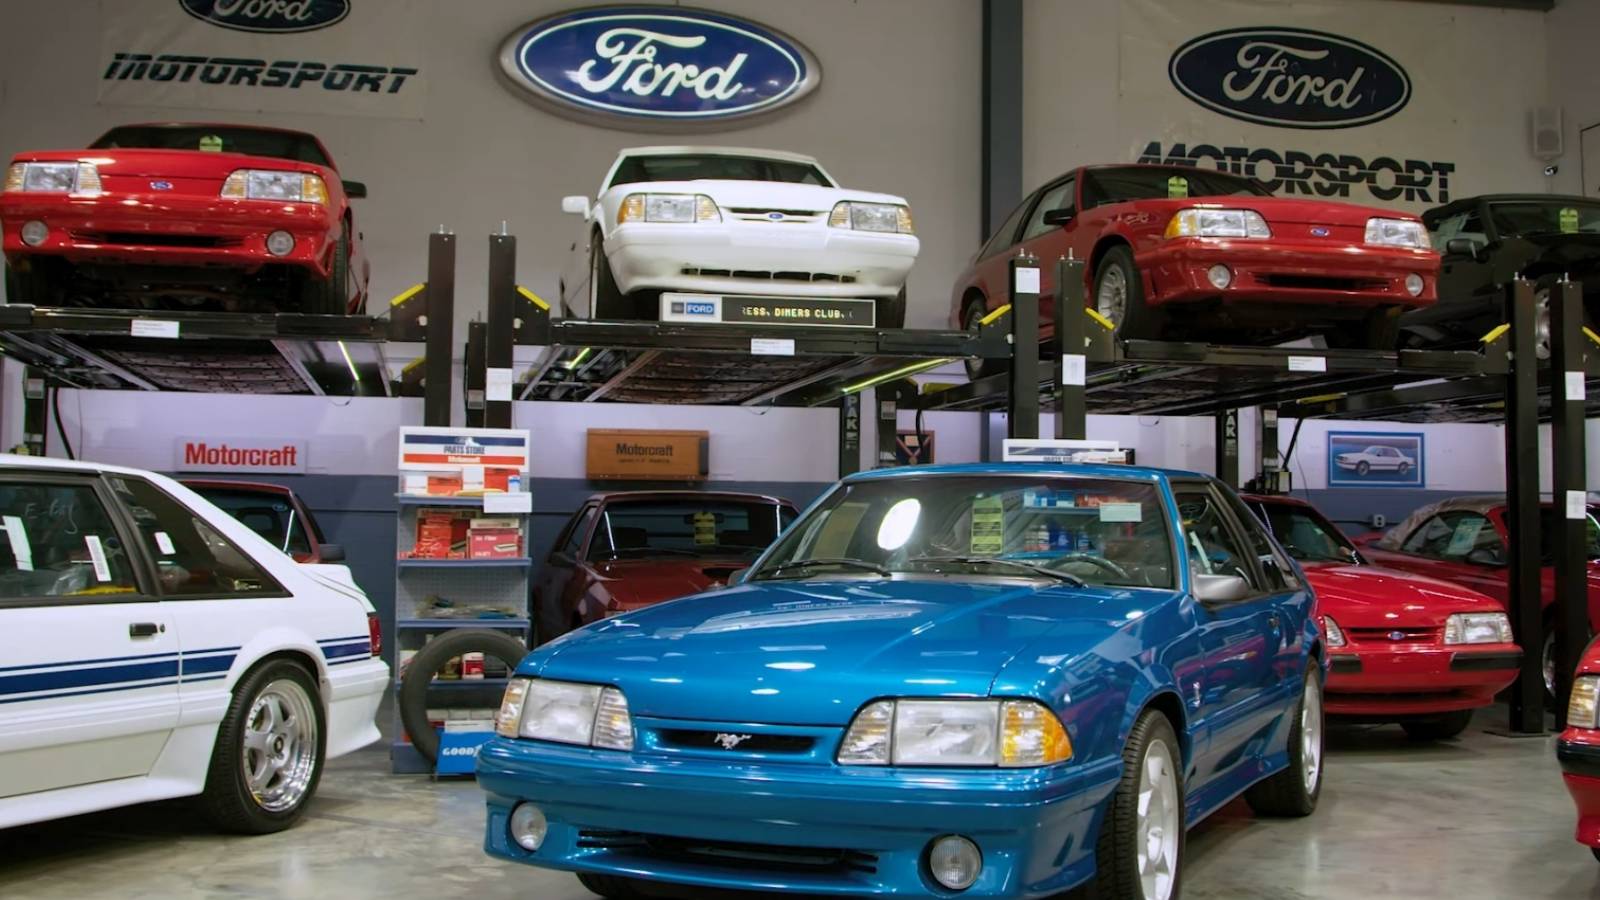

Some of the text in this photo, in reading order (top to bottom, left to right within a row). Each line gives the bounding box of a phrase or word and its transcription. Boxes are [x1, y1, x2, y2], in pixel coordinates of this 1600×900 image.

[104, 53, 418, 94] MOTORSPORT
[578, 28, 748, 100] Ford
[1222, 42, 1365, 109] Ford
[1137, 141, 1454, 204] MOTORSPORT
[687, 304, 713, 313] FORD
[185, 443, 297, 466] Motorcraft
[443, 445, 485, 454] PARTS STORE
[616, 443, 673, 456] Motorcraft
